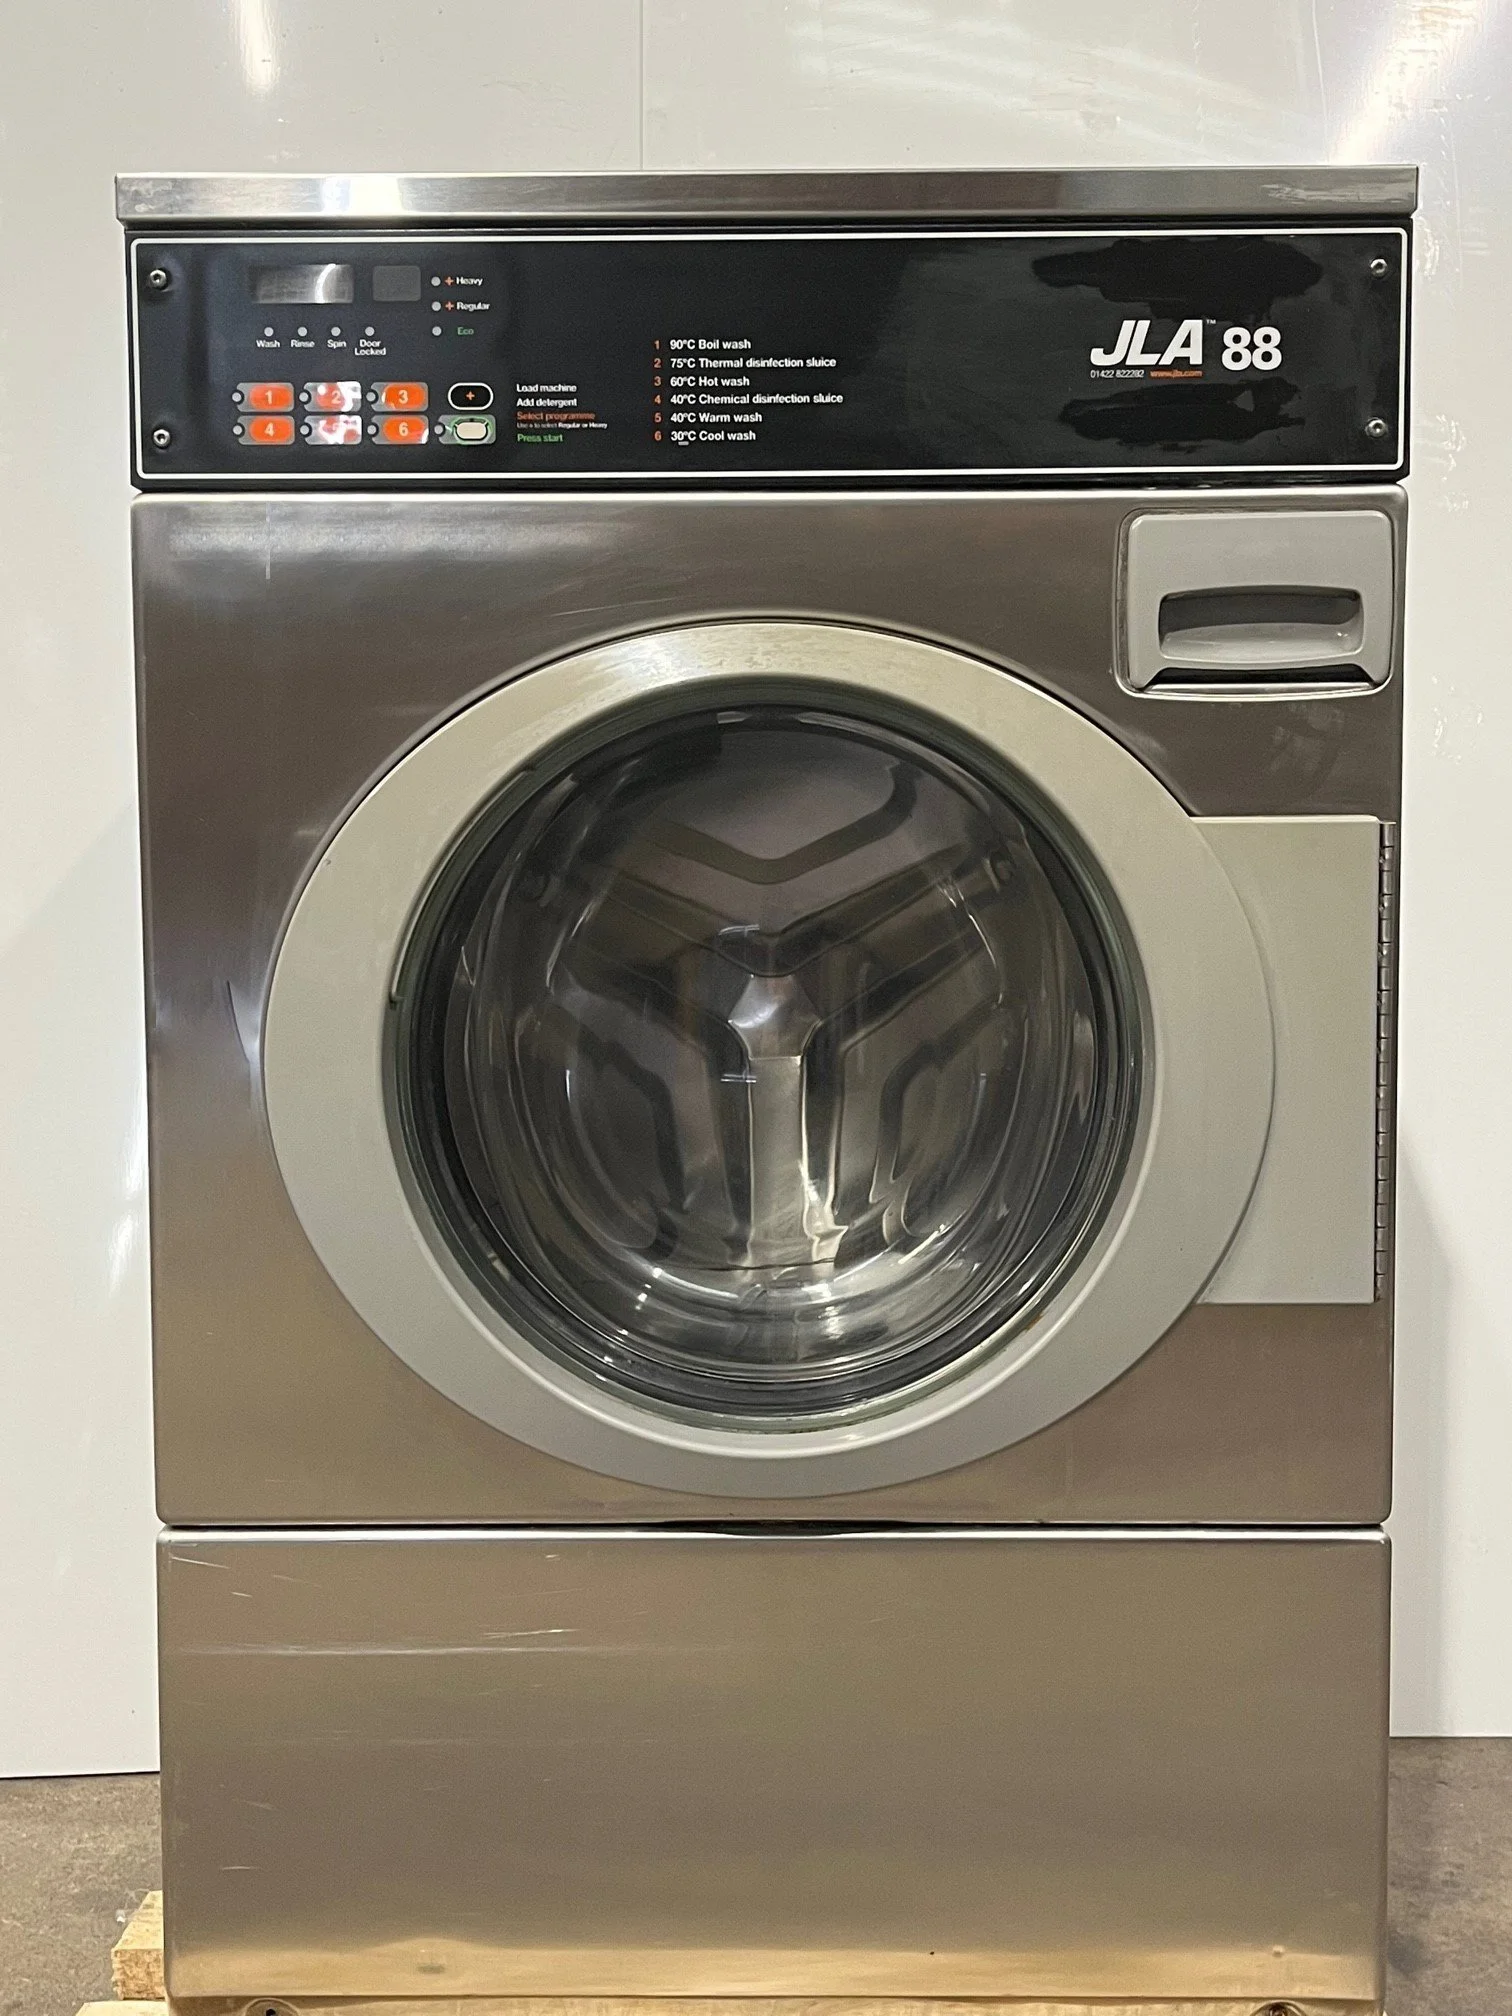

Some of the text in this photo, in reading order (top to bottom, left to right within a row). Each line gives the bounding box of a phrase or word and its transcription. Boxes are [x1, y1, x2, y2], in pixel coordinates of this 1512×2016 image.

[456, 276, 483, 286] Heavy
[456, 302, 490, 311] Regular
[457, 326, 475, 336] Eco
[256, 339, 281, 348] Wash
[290, 339, 315, 348] Rinse
[327, 339, 347, 349] Spin
[359, 339, 381, 347] Door
[654, 339, 751, 350] 1 90°C Boil wash
[1090, 319, 1203, 366] JLA
[1221, 326, 1282, 371] 88
[354, 347, 387, 356] Locked
[653, 357, 836, 369] 2 75°C Thermal disinfection sluice
[1090, 370, 1114, 378] 01422
[653, 376, 750, 387] 3 60°C Hot wash
[516, 384, 577, 393] Load machine
[265, 390, 272, 404] 1
[331, 391, 342, 404] 2
[398, 390, 409, 404] 3
[653, 392, 843, 405] 4 40°C Chemical disinfection sluice
[516, 398, 577, 408] Add detergent
[516, 411, 596, 421] Select programme
[654, 412, 762, 423] 5 40°C Warm wash
[264, 423, 274, 437] 4
[398, 422, 409, 436] 6
[589, 422, 608, 430] Heavy
[517, 434, 563, 442] Press start
[654, 431, 662, 441] 6
[699, 430, 725, 441] Cool
[727, 430, 757, 441] wash
